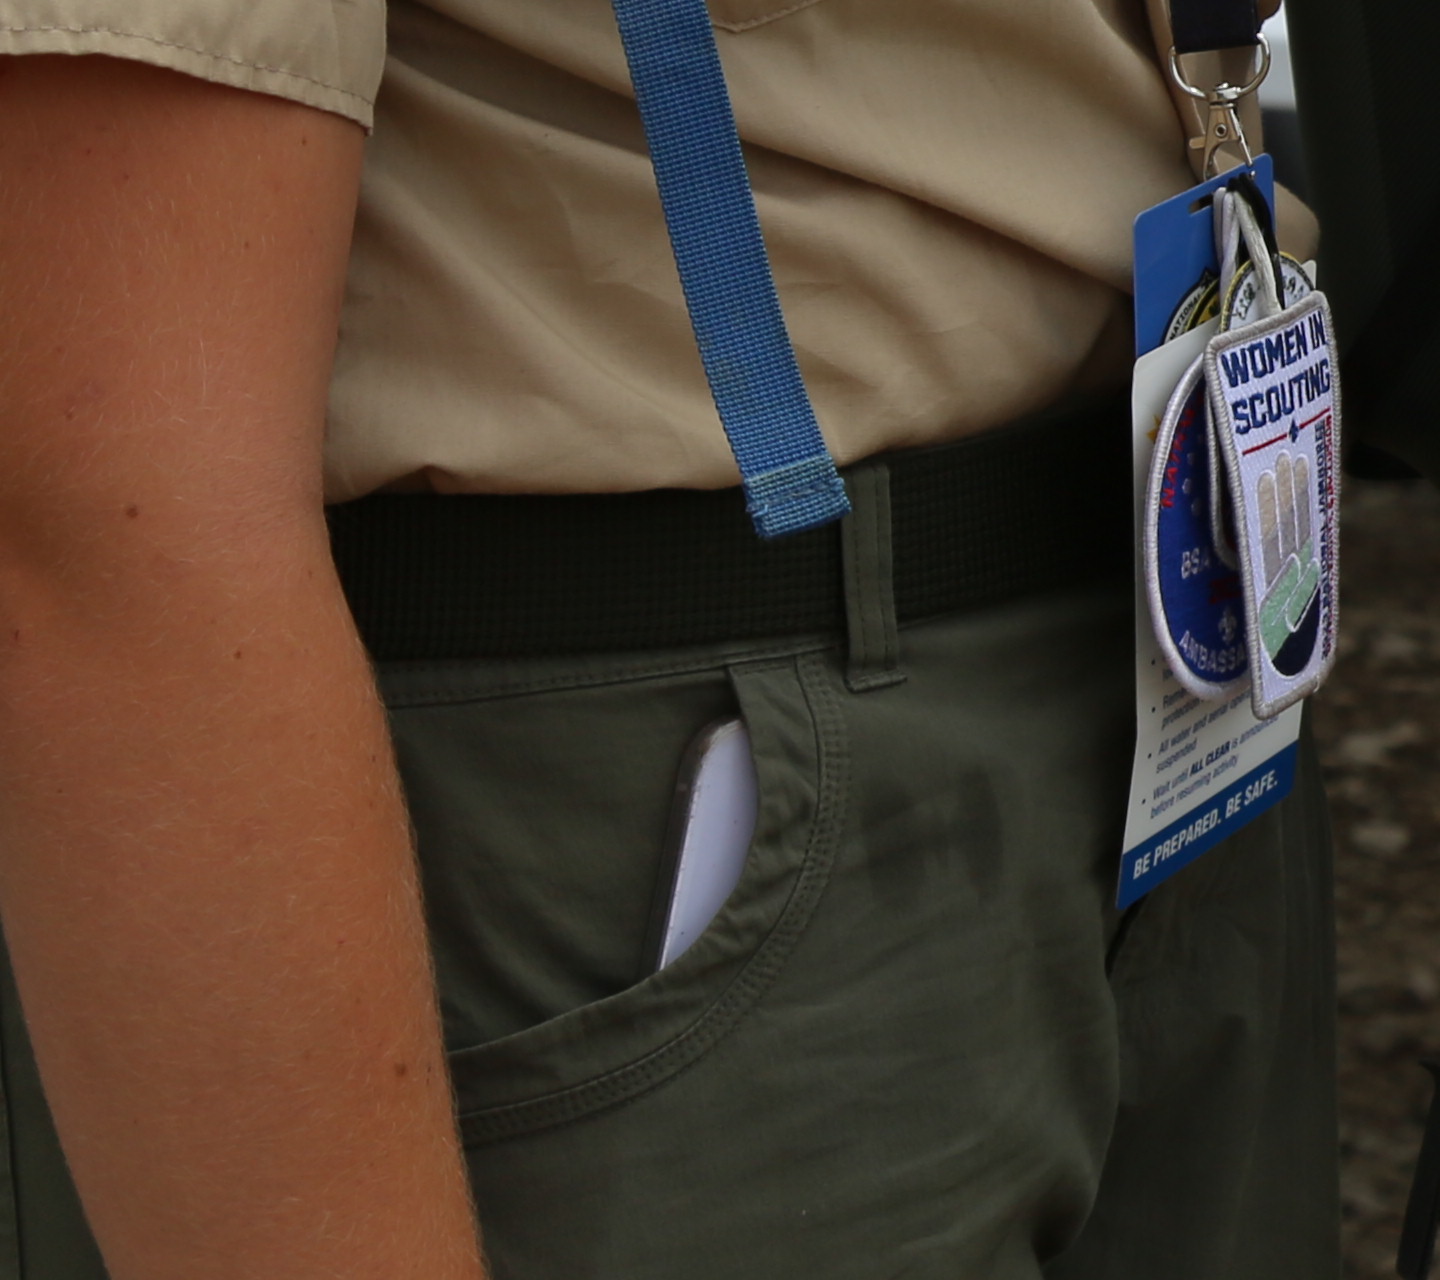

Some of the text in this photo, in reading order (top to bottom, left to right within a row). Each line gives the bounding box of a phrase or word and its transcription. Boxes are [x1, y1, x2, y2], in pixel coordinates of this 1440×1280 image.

[1220, 309, 1327, 388] WOMEN IN
[1231, 357, 1332, 436] SCOUTING
[1189, 758, 1204, 776] ALL
[1205, 740, 1231, 769] CLEAR
[1133, 769, 1278, 880] BE PREPARED. BE SAFE.
